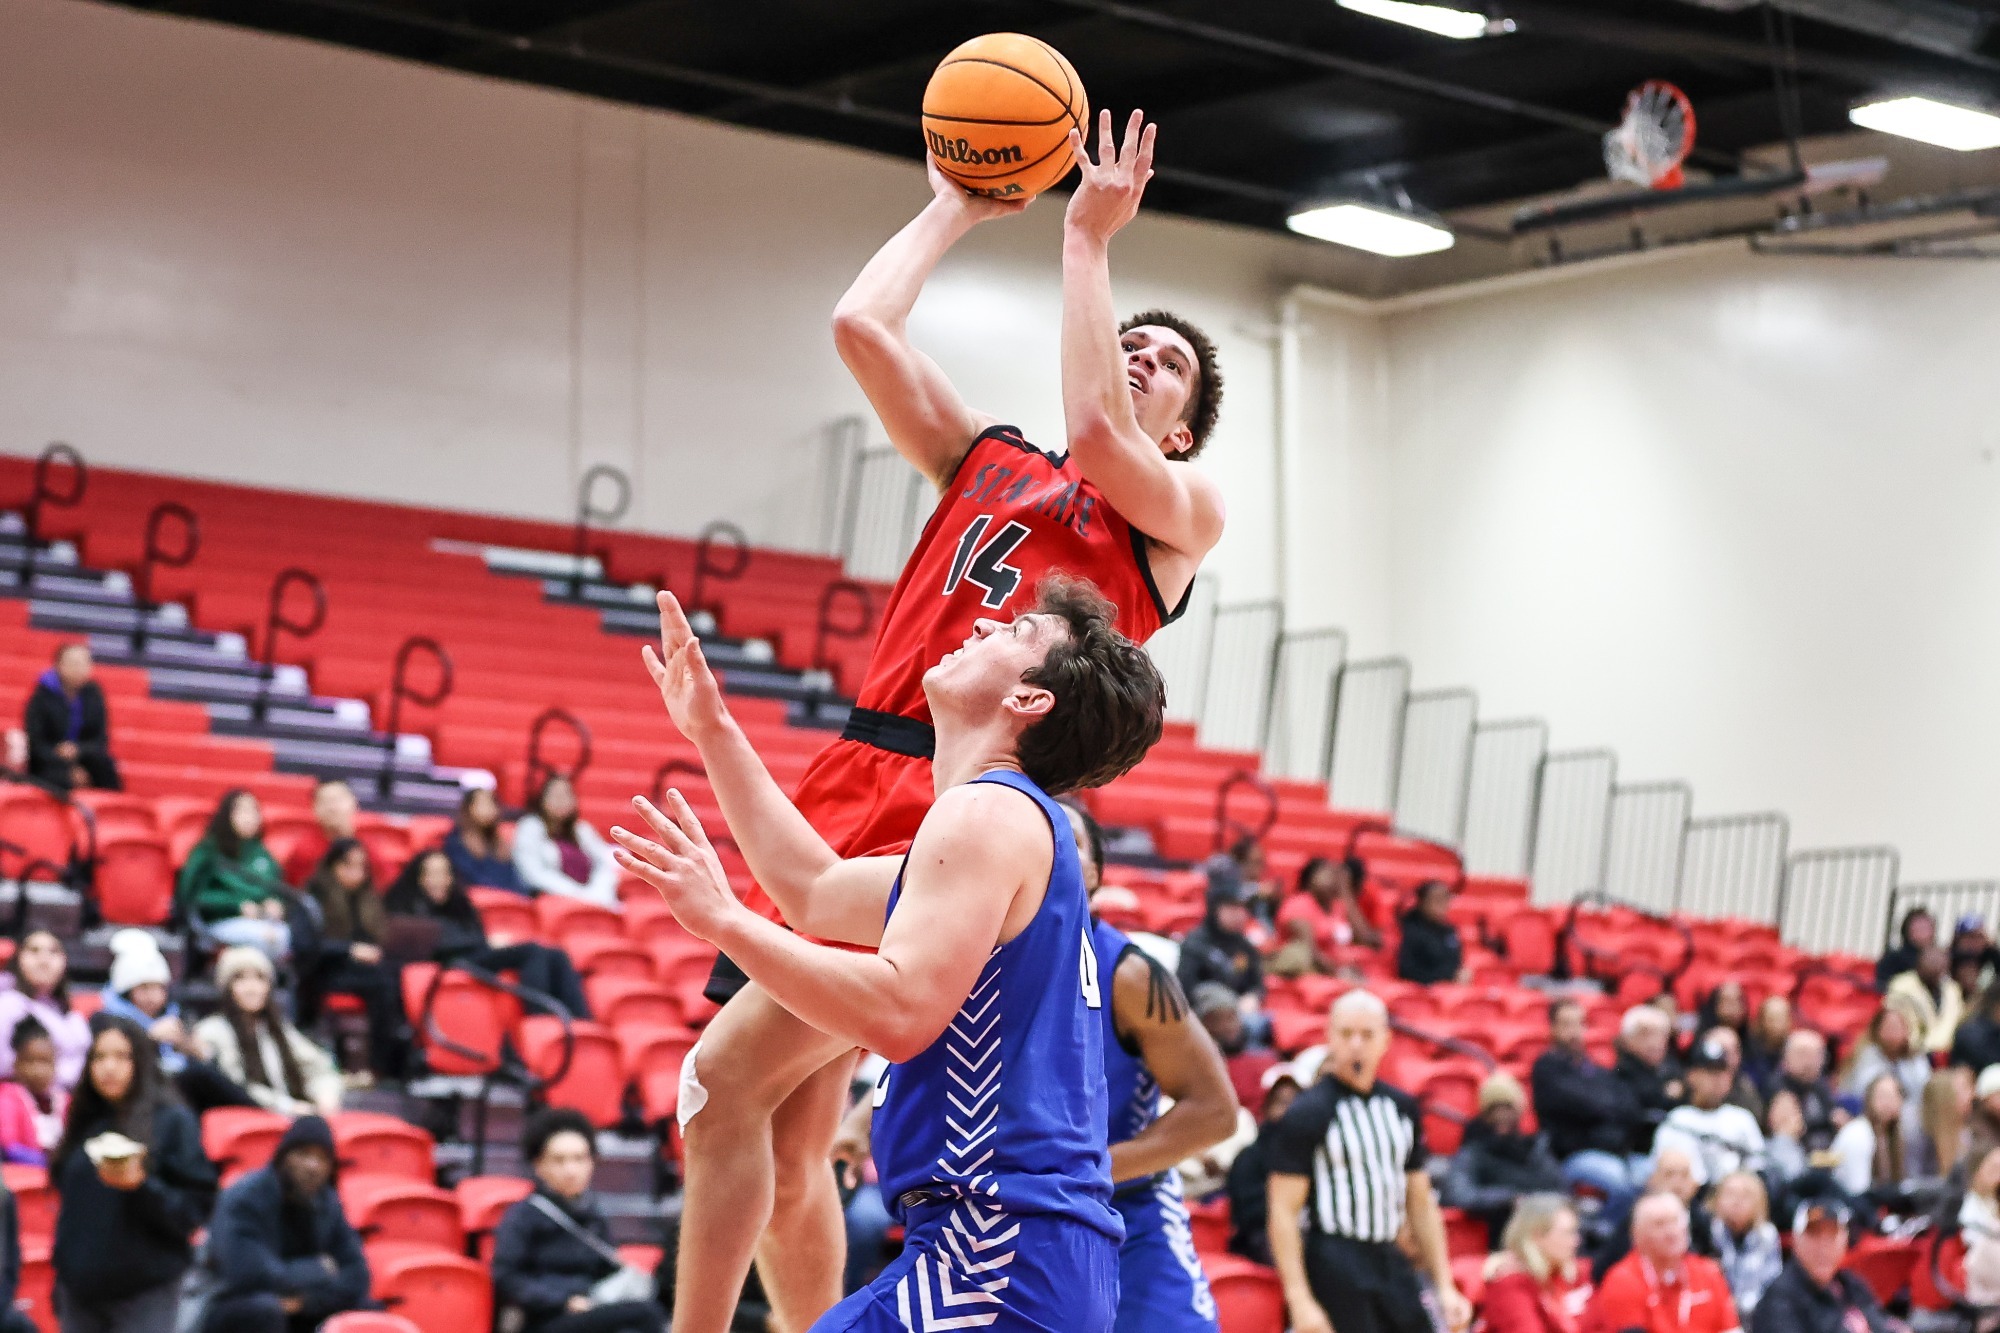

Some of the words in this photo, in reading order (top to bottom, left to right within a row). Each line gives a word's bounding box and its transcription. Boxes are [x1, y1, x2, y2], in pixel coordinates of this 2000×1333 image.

[926, 128, 1024, 165] Wilson
[961, 183, 1025, 198] AA
[941, 514, 1032, 610] 14
